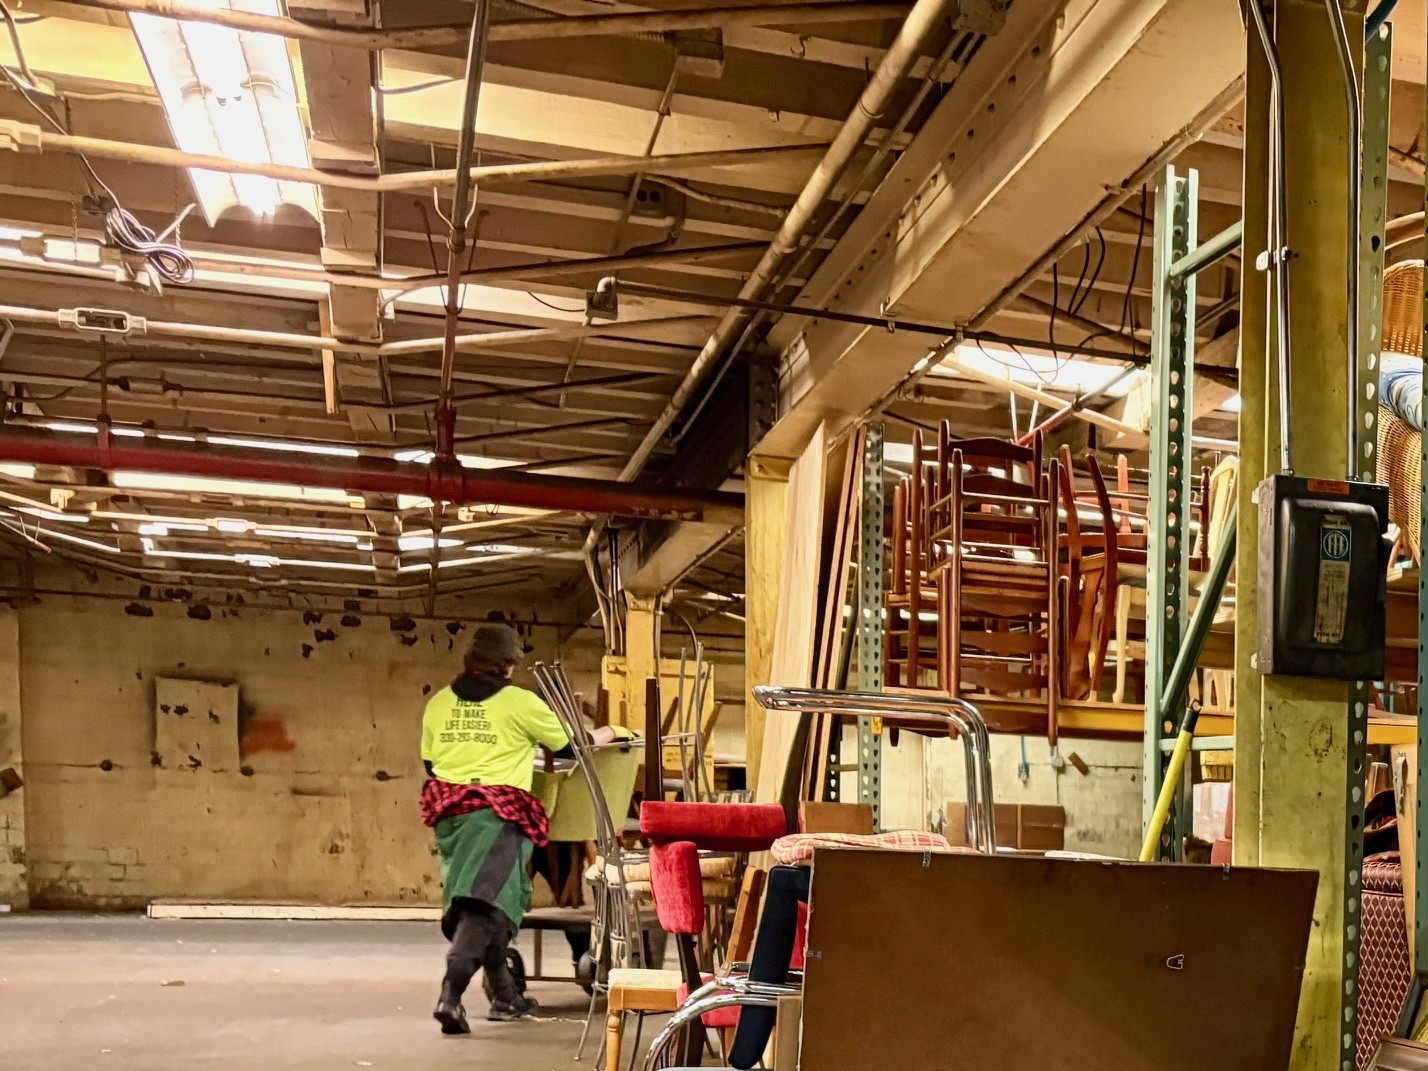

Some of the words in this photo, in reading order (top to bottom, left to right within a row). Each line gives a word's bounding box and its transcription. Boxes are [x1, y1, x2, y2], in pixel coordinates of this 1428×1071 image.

[451, 708, 461, 718] TO
[464, 709, 486, 719] MAKE
[445, 720, 460, 730] LIFE
